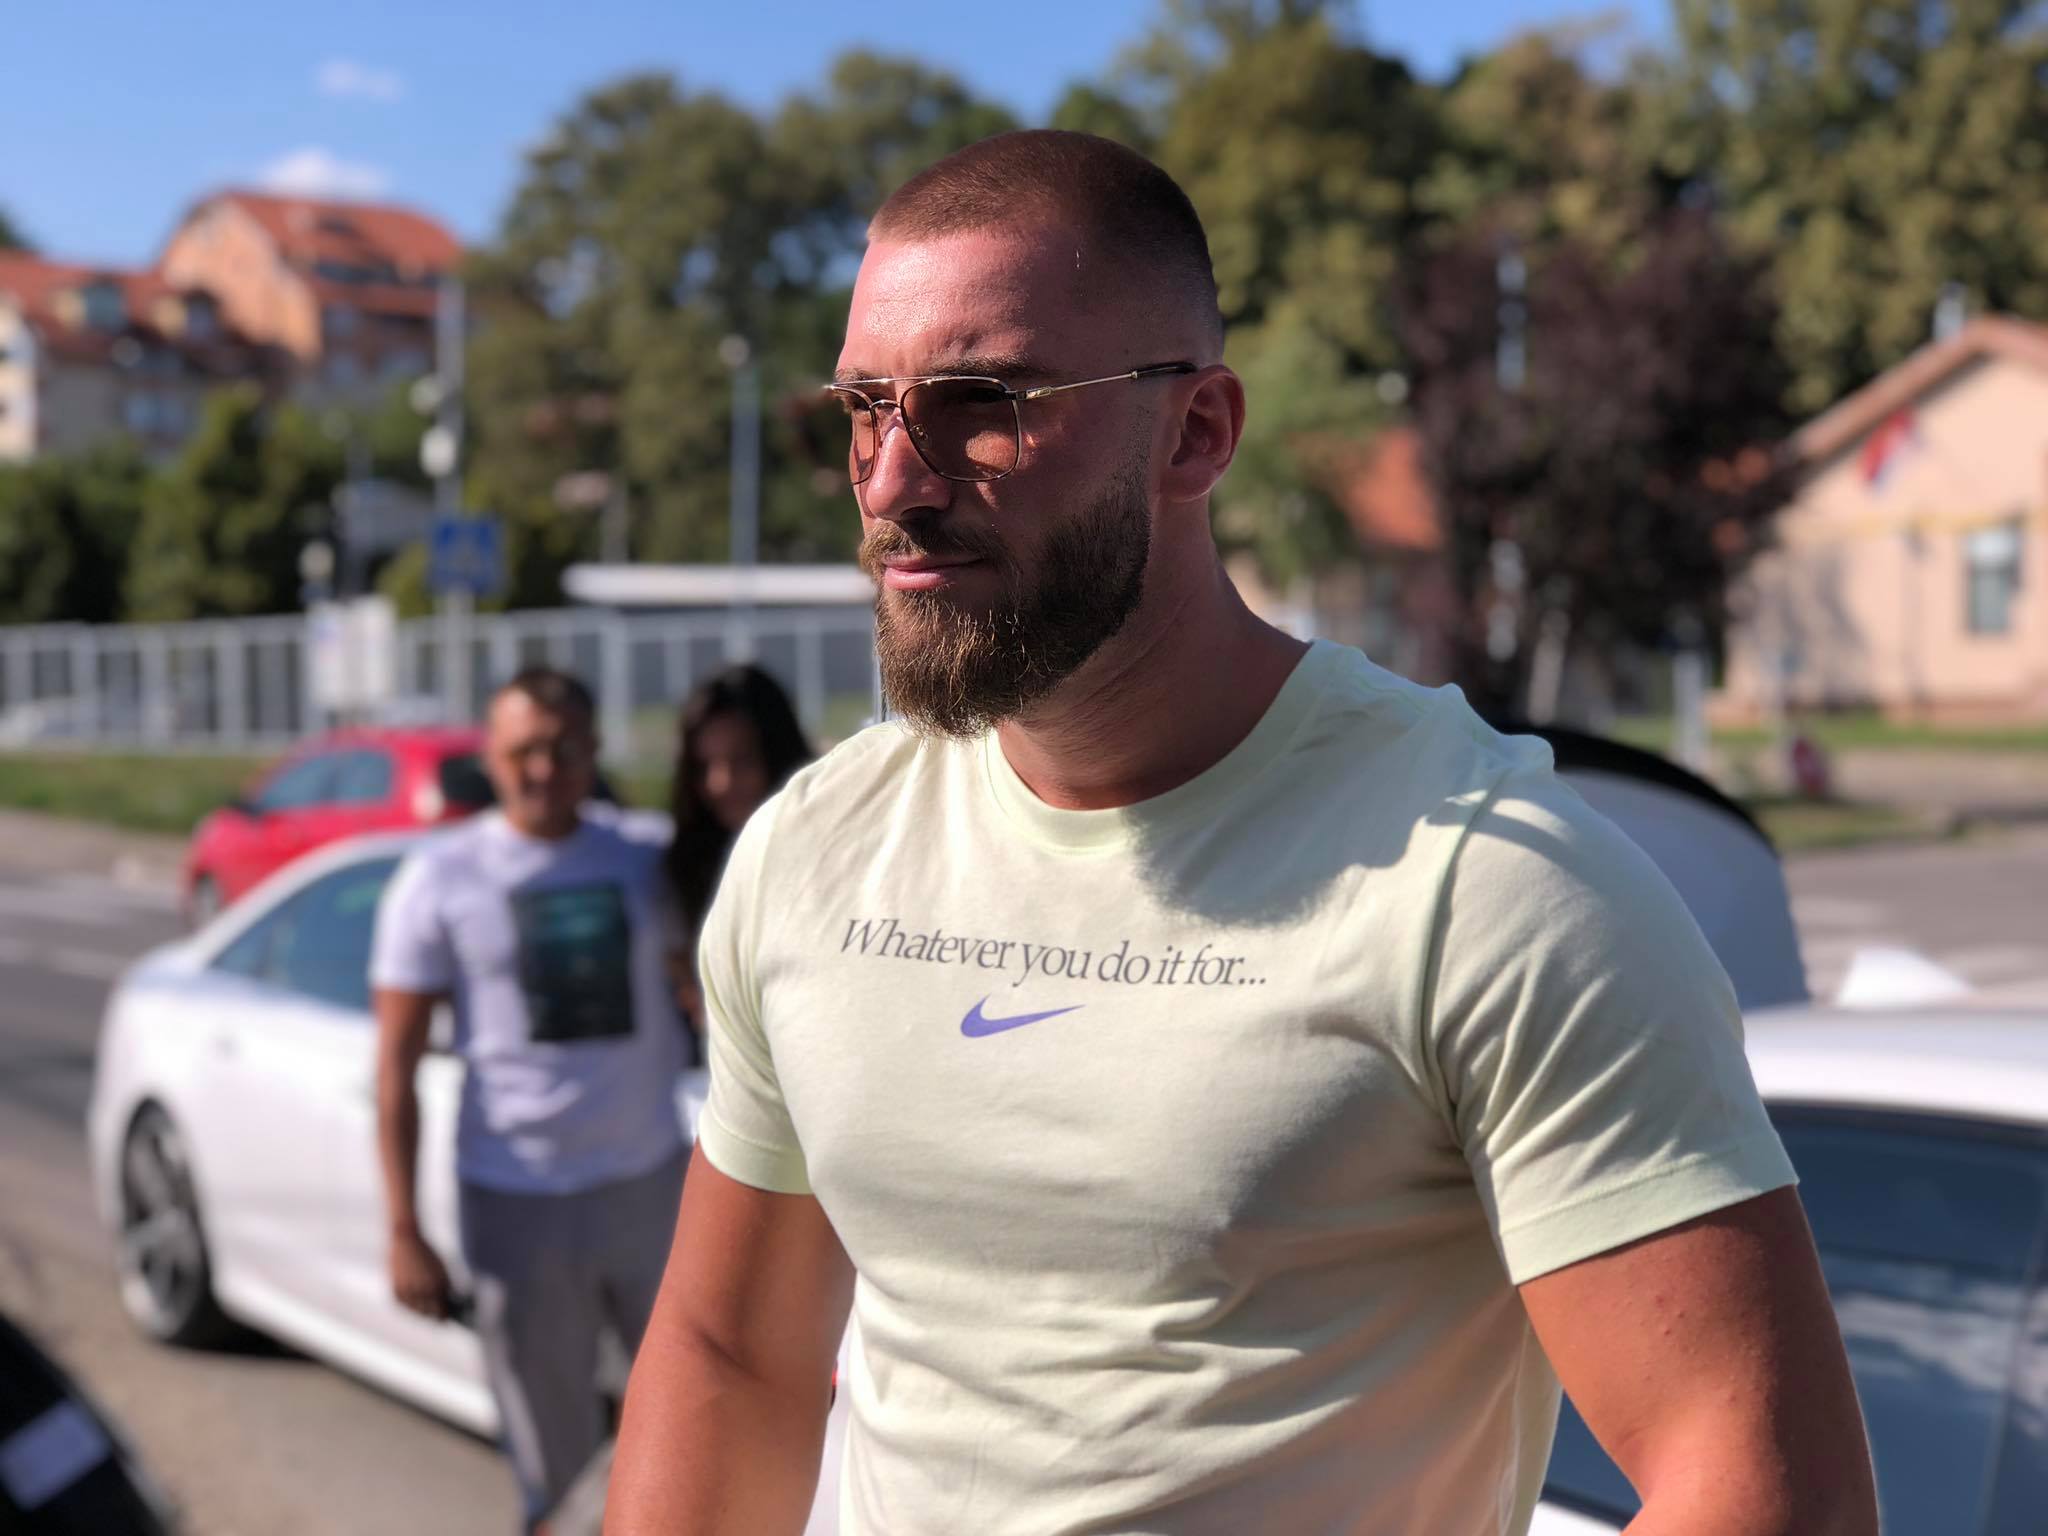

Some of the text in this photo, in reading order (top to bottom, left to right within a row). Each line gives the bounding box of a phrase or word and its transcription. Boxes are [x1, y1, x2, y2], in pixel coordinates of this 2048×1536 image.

[840, 918, 1267, 988] Whatever you do it for...
